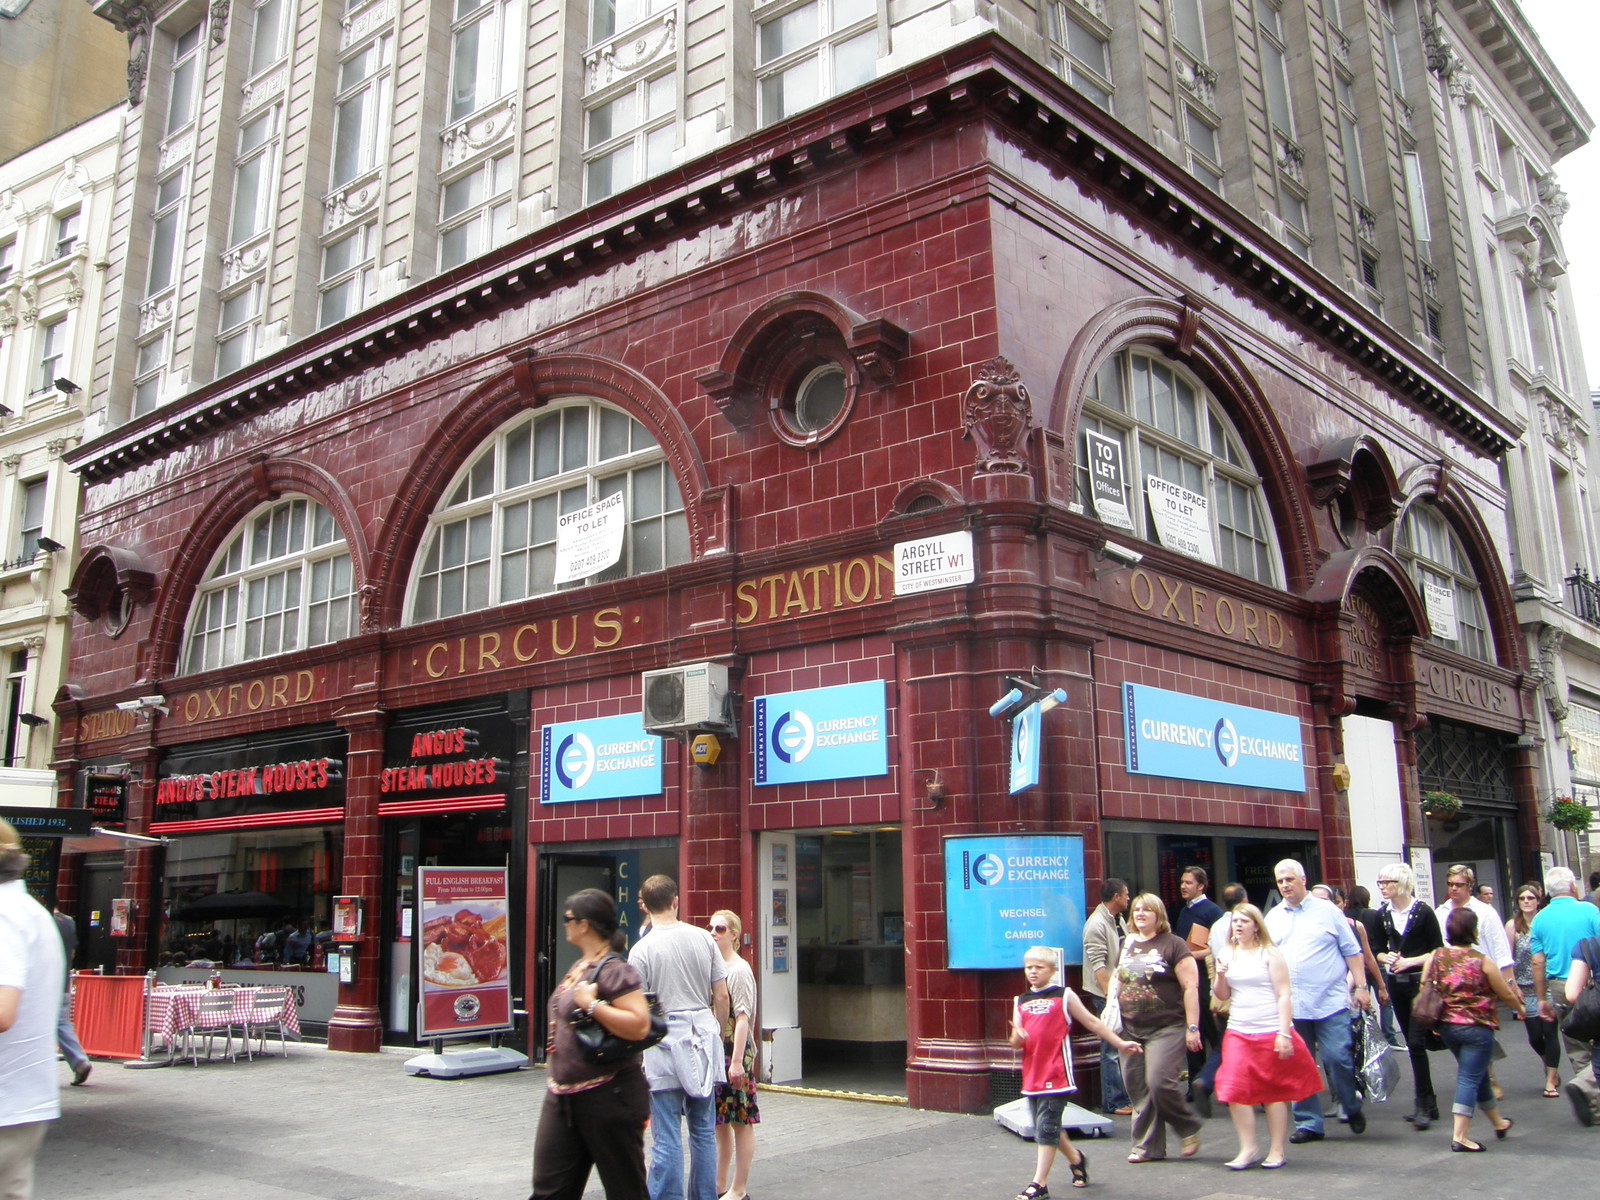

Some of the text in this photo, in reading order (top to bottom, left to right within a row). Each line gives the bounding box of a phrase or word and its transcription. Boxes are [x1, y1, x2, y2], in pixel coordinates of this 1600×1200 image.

[1095, 442, 1113, 461] TO
[1095, 459, 1116, 479] LET
[1096, 480, 1120, 497] Offices
[1150, 478, 1207, 509] OFFICE SPACE
[559, 494, 622, 527] OFFICE SPACE
[1165, 498, 1194, 517] TO LET
[577, 515, 608, 534] TO LET
[901, 540, 945, 561] ARGYLL
[901, 553, 964, 577] STREET W1
[735, 551, 894, 625] STATION
[902, 583, 914, 591] CITY
[923, 574, 962, 587] WESTMINSTER
[1130, 568, 1284, 649] OXFORD
[1345, 594, 1379, 629] XFORD
[426, 606, 623, 678] CIRCUS
[1348, 623, 1379, 649] IRCUS
[1350, 648, 1381, 673] OUSE
[185, 670, 316, 722] OXFORD
[1428, 664, 1502, 711] CIRCUS
[816, 714, 879, 733] CURRENCY
[1129, 689, 1137, 767] INTERNATIONAL
[411, 727, 465, 758] ANGUS
[596, 738, 657, 756] CURRENCY
[816, 729, 879, 748] EXCHANGE
[1141, 718, 1299, 762] CURRENCY EXCHANGE
[695, 744, 708, 754] ADT
[596, 755, 656, 772] EXCHANGE
[156, 758, 329, 805] ANGUS STEAK HOUSES
[380, 757, 496, 793] STEAK HOUSES
[48, 818, 66, 827] 1932
[1007, 856, 1069, 868] CURRENCY
[425, 876, 504, 885] FULL ENGLISH BREAKFAST
[1007, 869, 1070, 881] EXCHANGE
[1000, 908, 1047, 918] WECHSEL
[1004, 930, 1044, 939] CAMBIO
